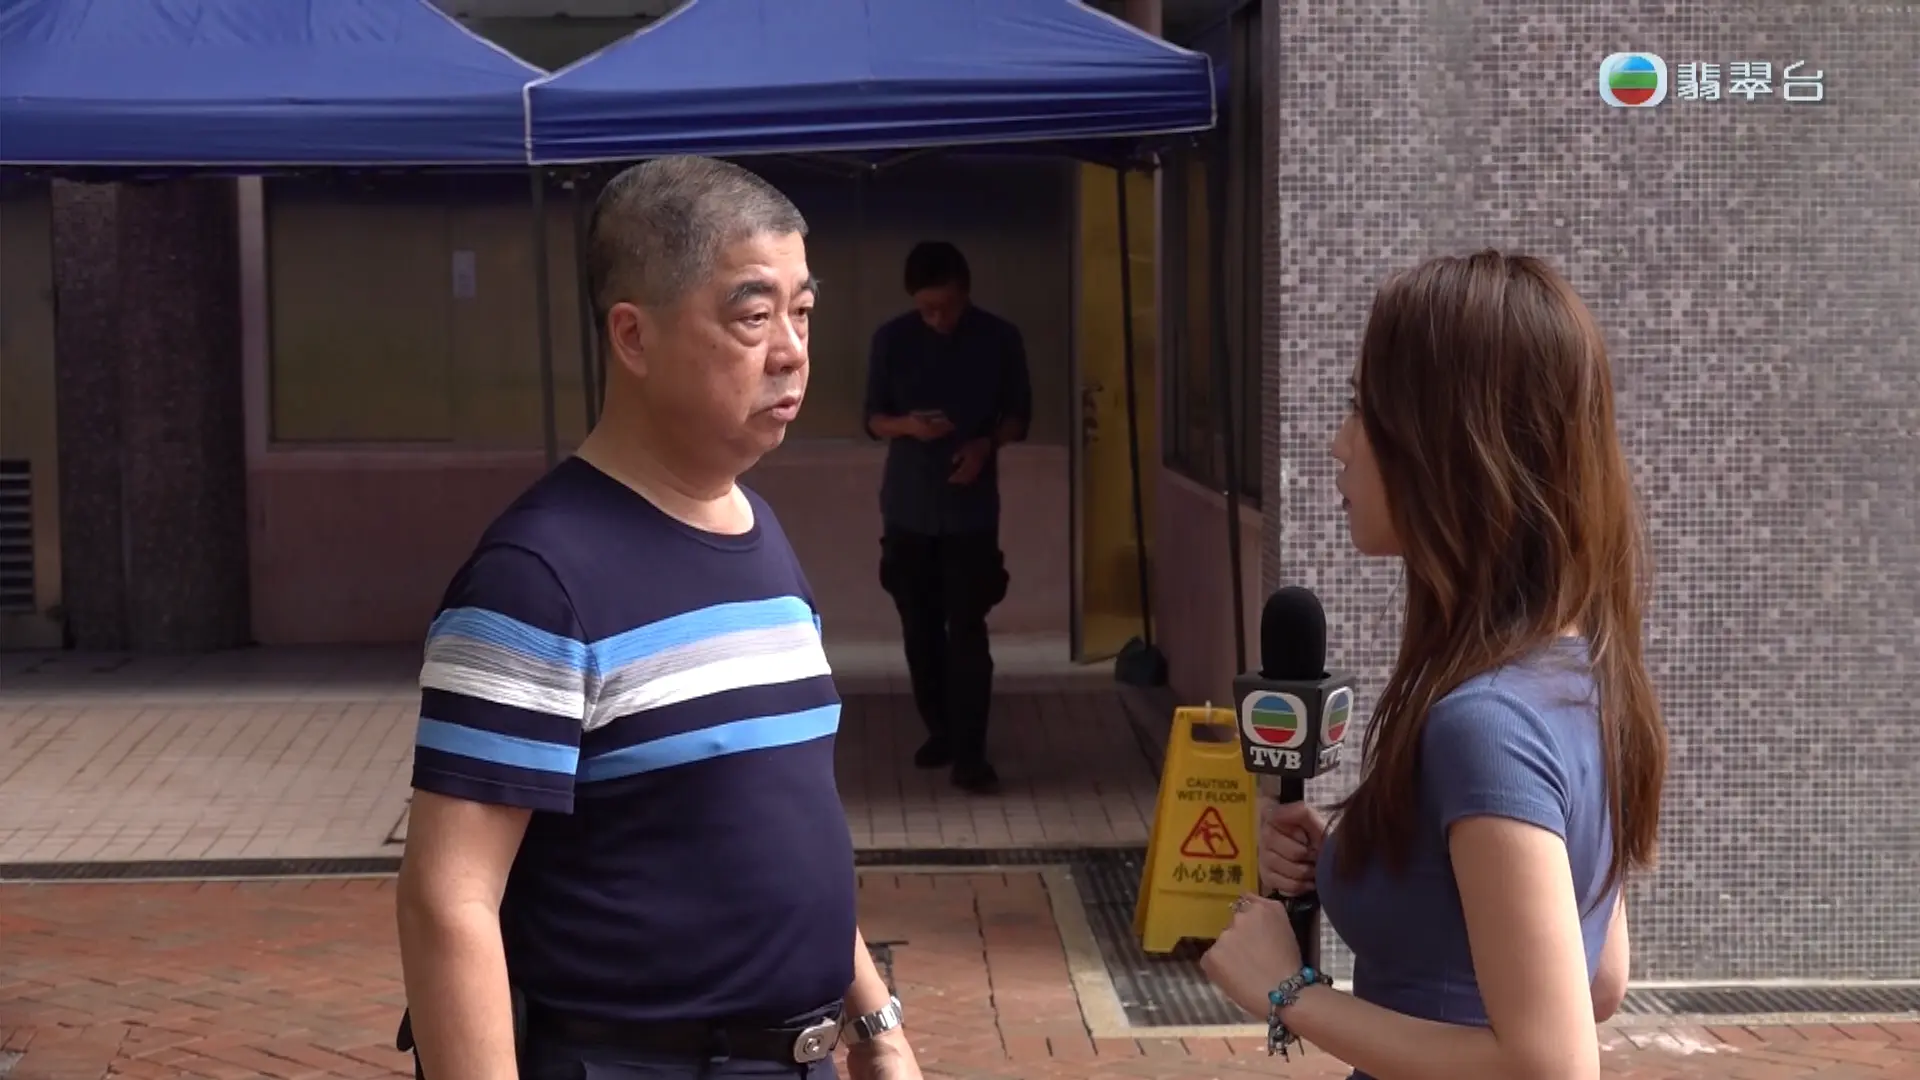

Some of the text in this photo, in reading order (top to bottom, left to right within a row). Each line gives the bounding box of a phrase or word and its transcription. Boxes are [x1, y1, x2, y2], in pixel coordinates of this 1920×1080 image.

[1250, 746, 1302, 769] TVB
[1186, 777, 1239, 790] CAUTION
[1177, 790, 1247, 804] WET FLOOR
[1172, 864, 1244, 885] 小心地滑
